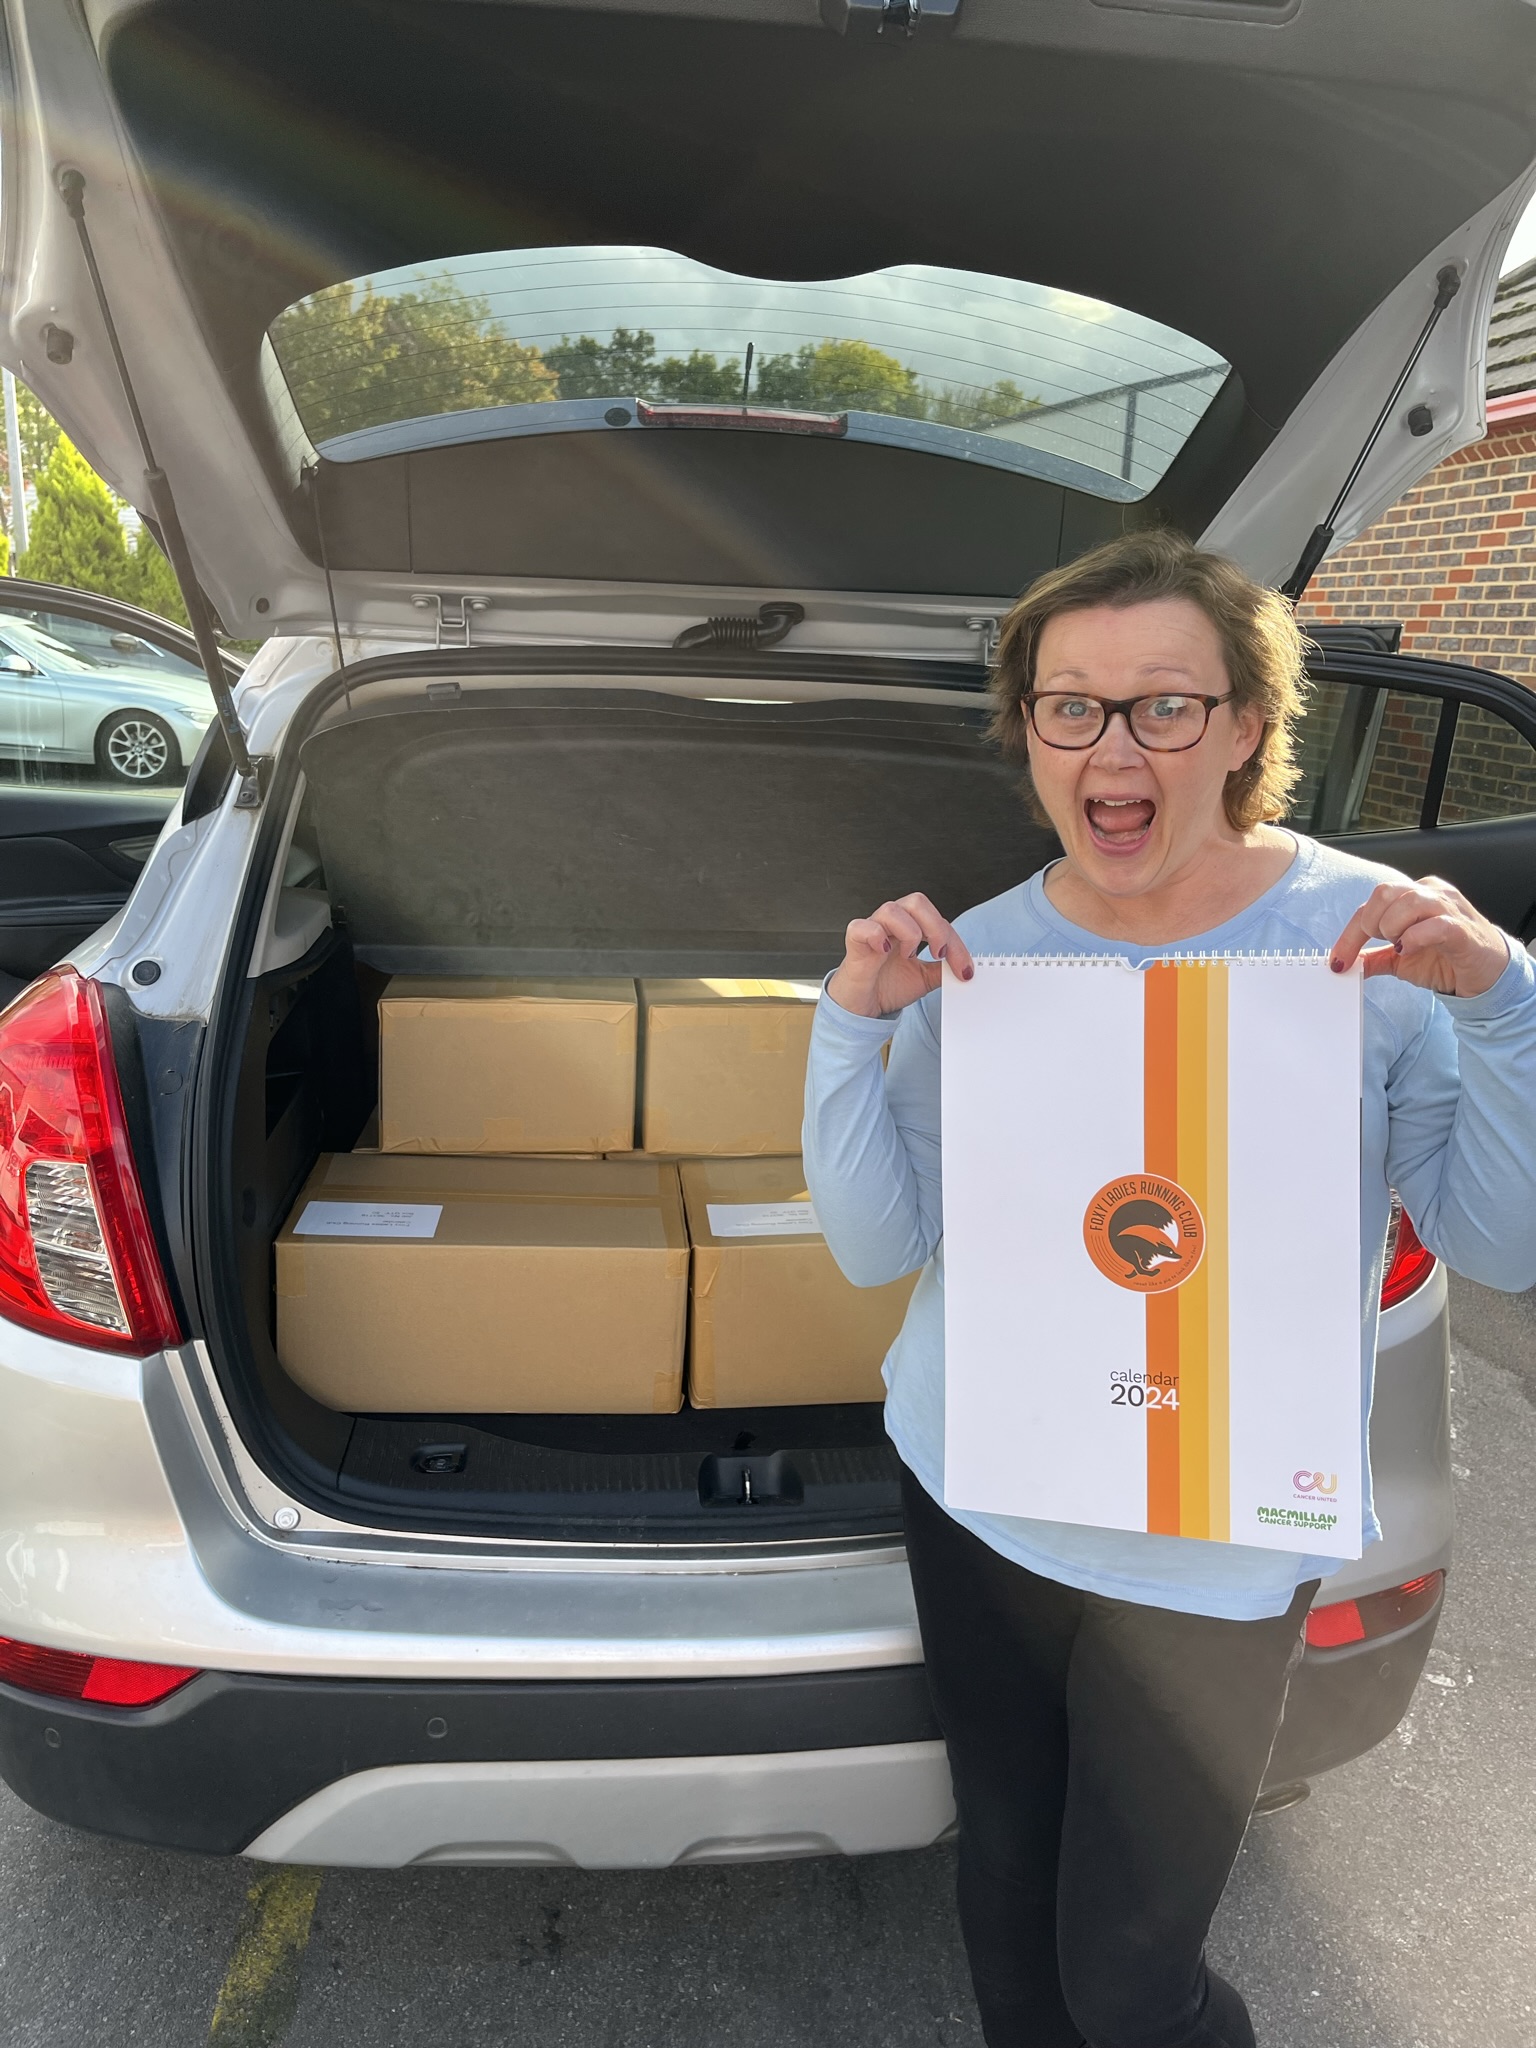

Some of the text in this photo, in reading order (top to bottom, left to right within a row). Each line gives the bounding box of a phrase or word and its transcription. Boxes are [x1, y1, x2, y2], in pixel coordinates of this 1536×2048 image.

[1090, 1181, 1197, 1238] FOXY LADIES RUNNING CLUB
[1110, 1368, 1179, 1386] calendar
[1110, 1383, 1180, 1411] 2024
[1293, 1493, 1316, 1501] CANCER
[1257, 1506, 1337, 1524] MACMILLAN
[1258, 1516, 1333, 1531] CANCER SUPPORT
